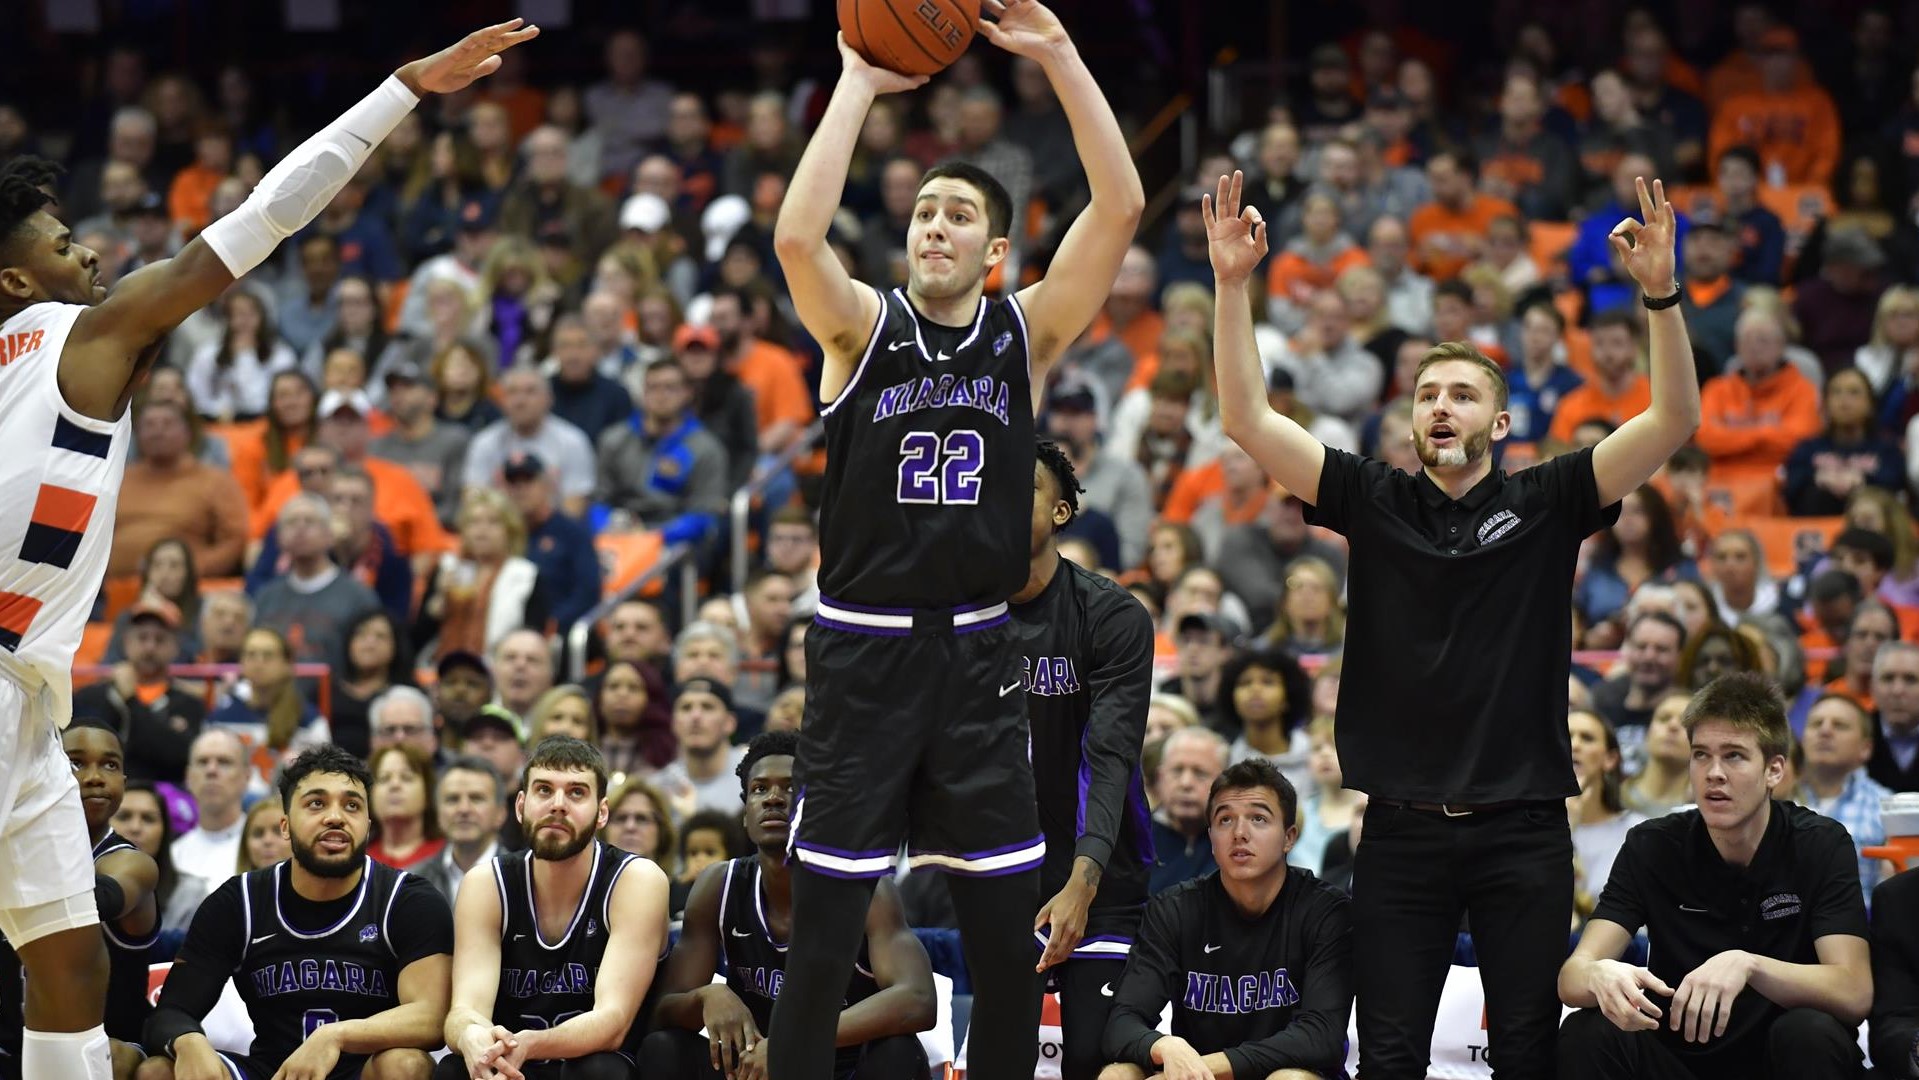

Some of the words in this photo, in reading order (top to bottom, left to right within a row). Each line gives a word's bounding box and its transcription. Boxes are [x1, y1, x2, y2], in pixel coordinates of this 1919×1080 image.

[917, 0, 964, 49] ELITE
[873, 374, 1010, 426] NIAGARA
[897, 429, 985, 505] 22
[252, 958, 389, 999] NIAGARA
[502, 962, 600, 999] IAGAR
[1183, 967, 1300, 1014] NIAGARA
